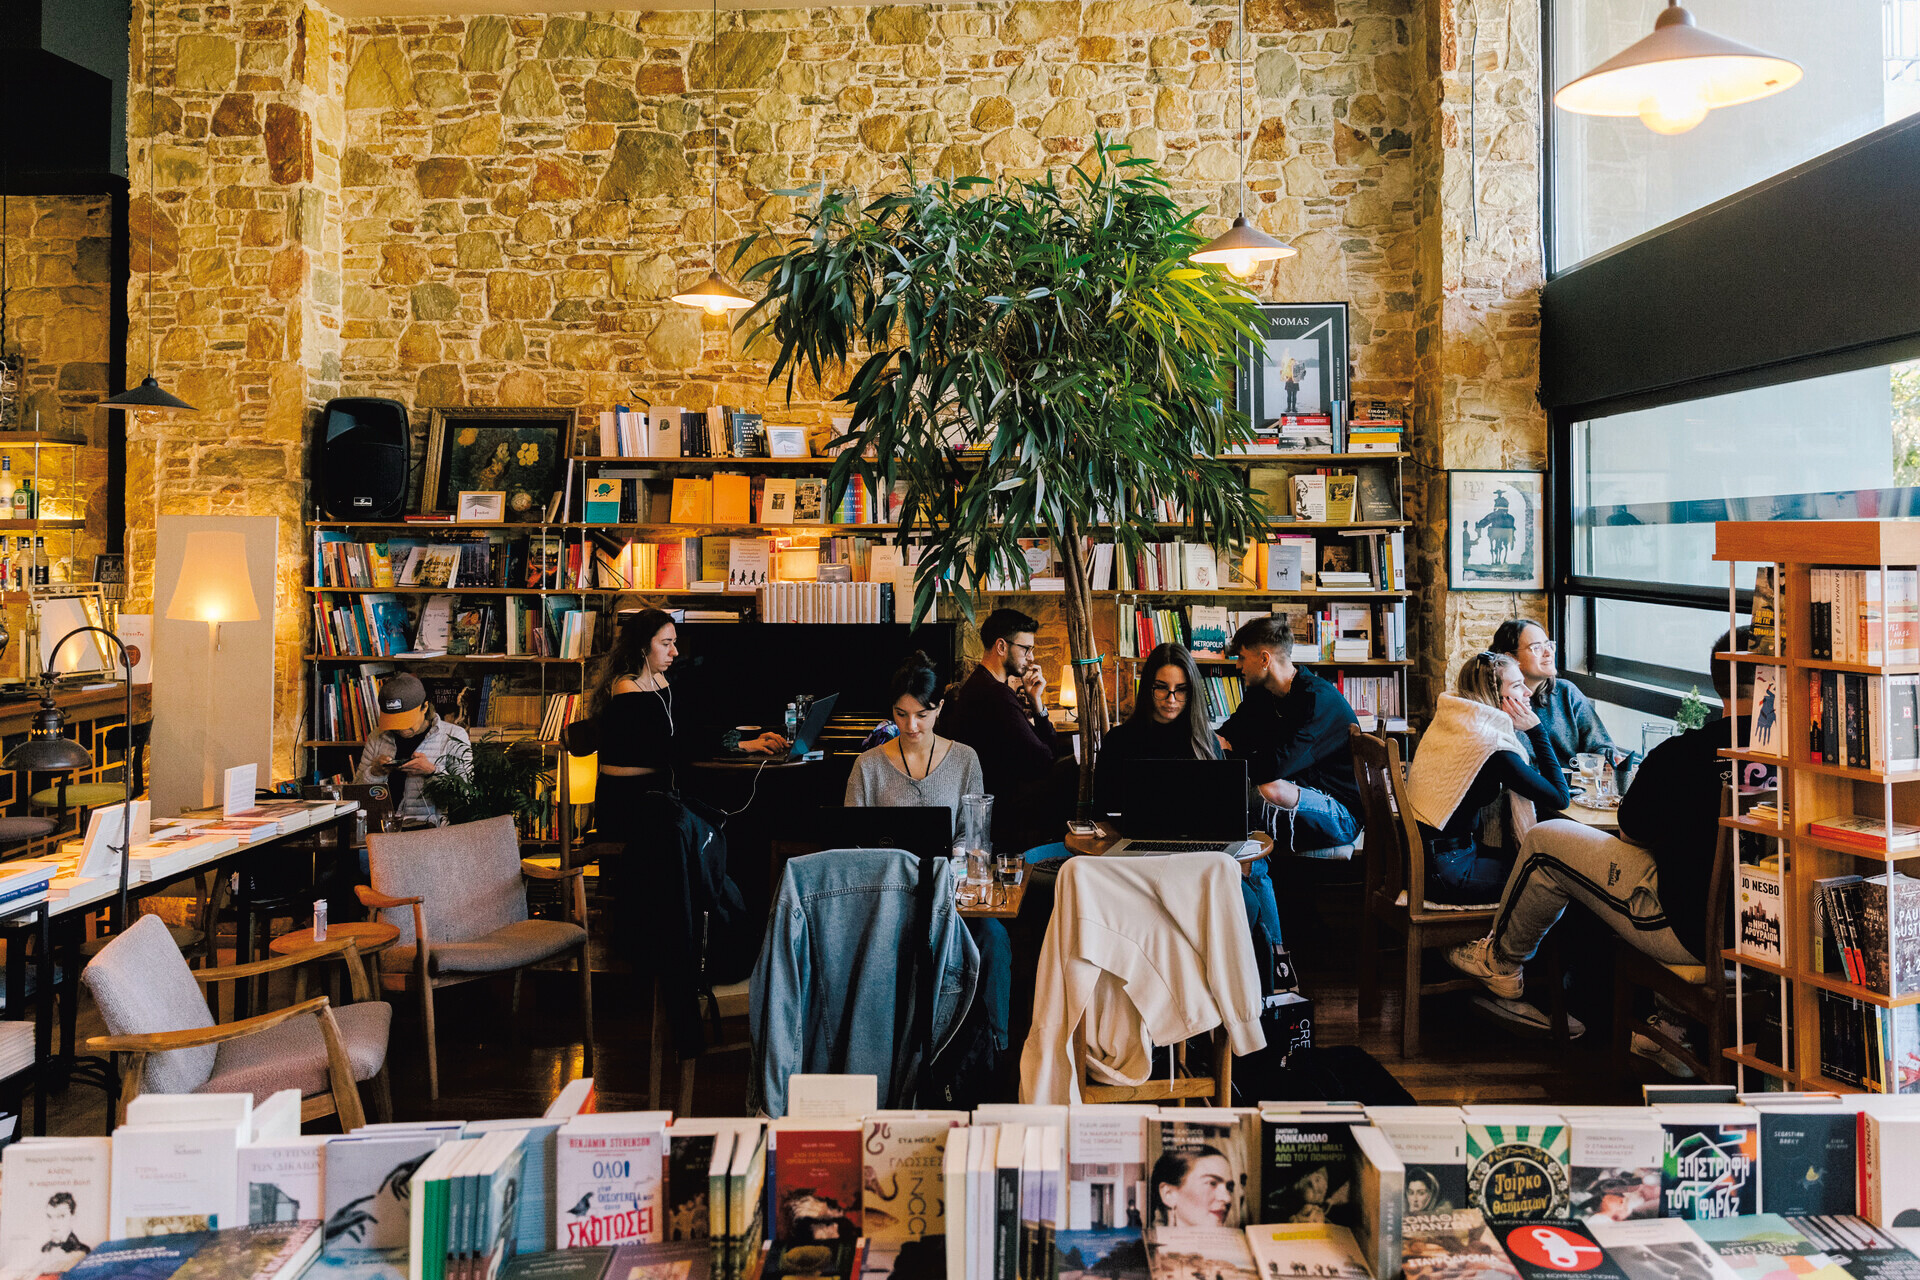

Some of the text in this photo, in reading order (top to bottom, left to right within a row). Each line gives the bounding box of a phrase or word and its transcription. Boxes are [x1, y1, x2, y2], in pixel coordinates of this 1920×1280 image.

[1271, 317, 1311, 327] NOMAS
[1193, 640, 1224, 649] METROPOLIS
[1741, 877, 1780, 896] JO NESBO
[1866, 907, 1880, 916] PAUL
[1899, 910, 1920, 923] PAU
[1752, 919, 1769, 931] ΝΗΣΙ
[1744, 926, 1778, 942] ΑΡΟΥΡΑΙΩΝ
[1299, 1018, 1311, 1049] CRE
[1275, 1133, 1328, 1143] ΡΟΝΚΑΛΙΟΛΟ
[1774, 1130, 1805, 1138] SEBASTIAN
[569, 1136, 651, 1148] BENJAMIN STEVENSON
[1275, 1143, 1296, 1153] ΑΛΛΑ
[889, 1156, 944, 1168] ΓΛΩΣΣΕΣ
[1275, 1153, 1292, 1162] ΑΠΟ
[1293, 1153, 1308, 1162] ΤΟΥ
[592, 1160, 631, 1179] ΟΛΟΙ
[1514, 1162, 1525, 1174] Το
[1677, 1156, 1751, 1178] ΕΠΙΣΤΡΟΦΗ
[1494, 1173, 1542, 1196] Τσίρκο
[1665, 1188, 1691, 1209] ΤΟΥ
[1699, 1189, 1740, 1219] ΦΑΡΑΖ
[908, 1177, 927, 1235] ΖΩΩ
[1492, 1195, 1550, 1217] Θαυμάτων
[567, 1206, 654, 1249] ΣΚΟΤΩΣΕΙ
